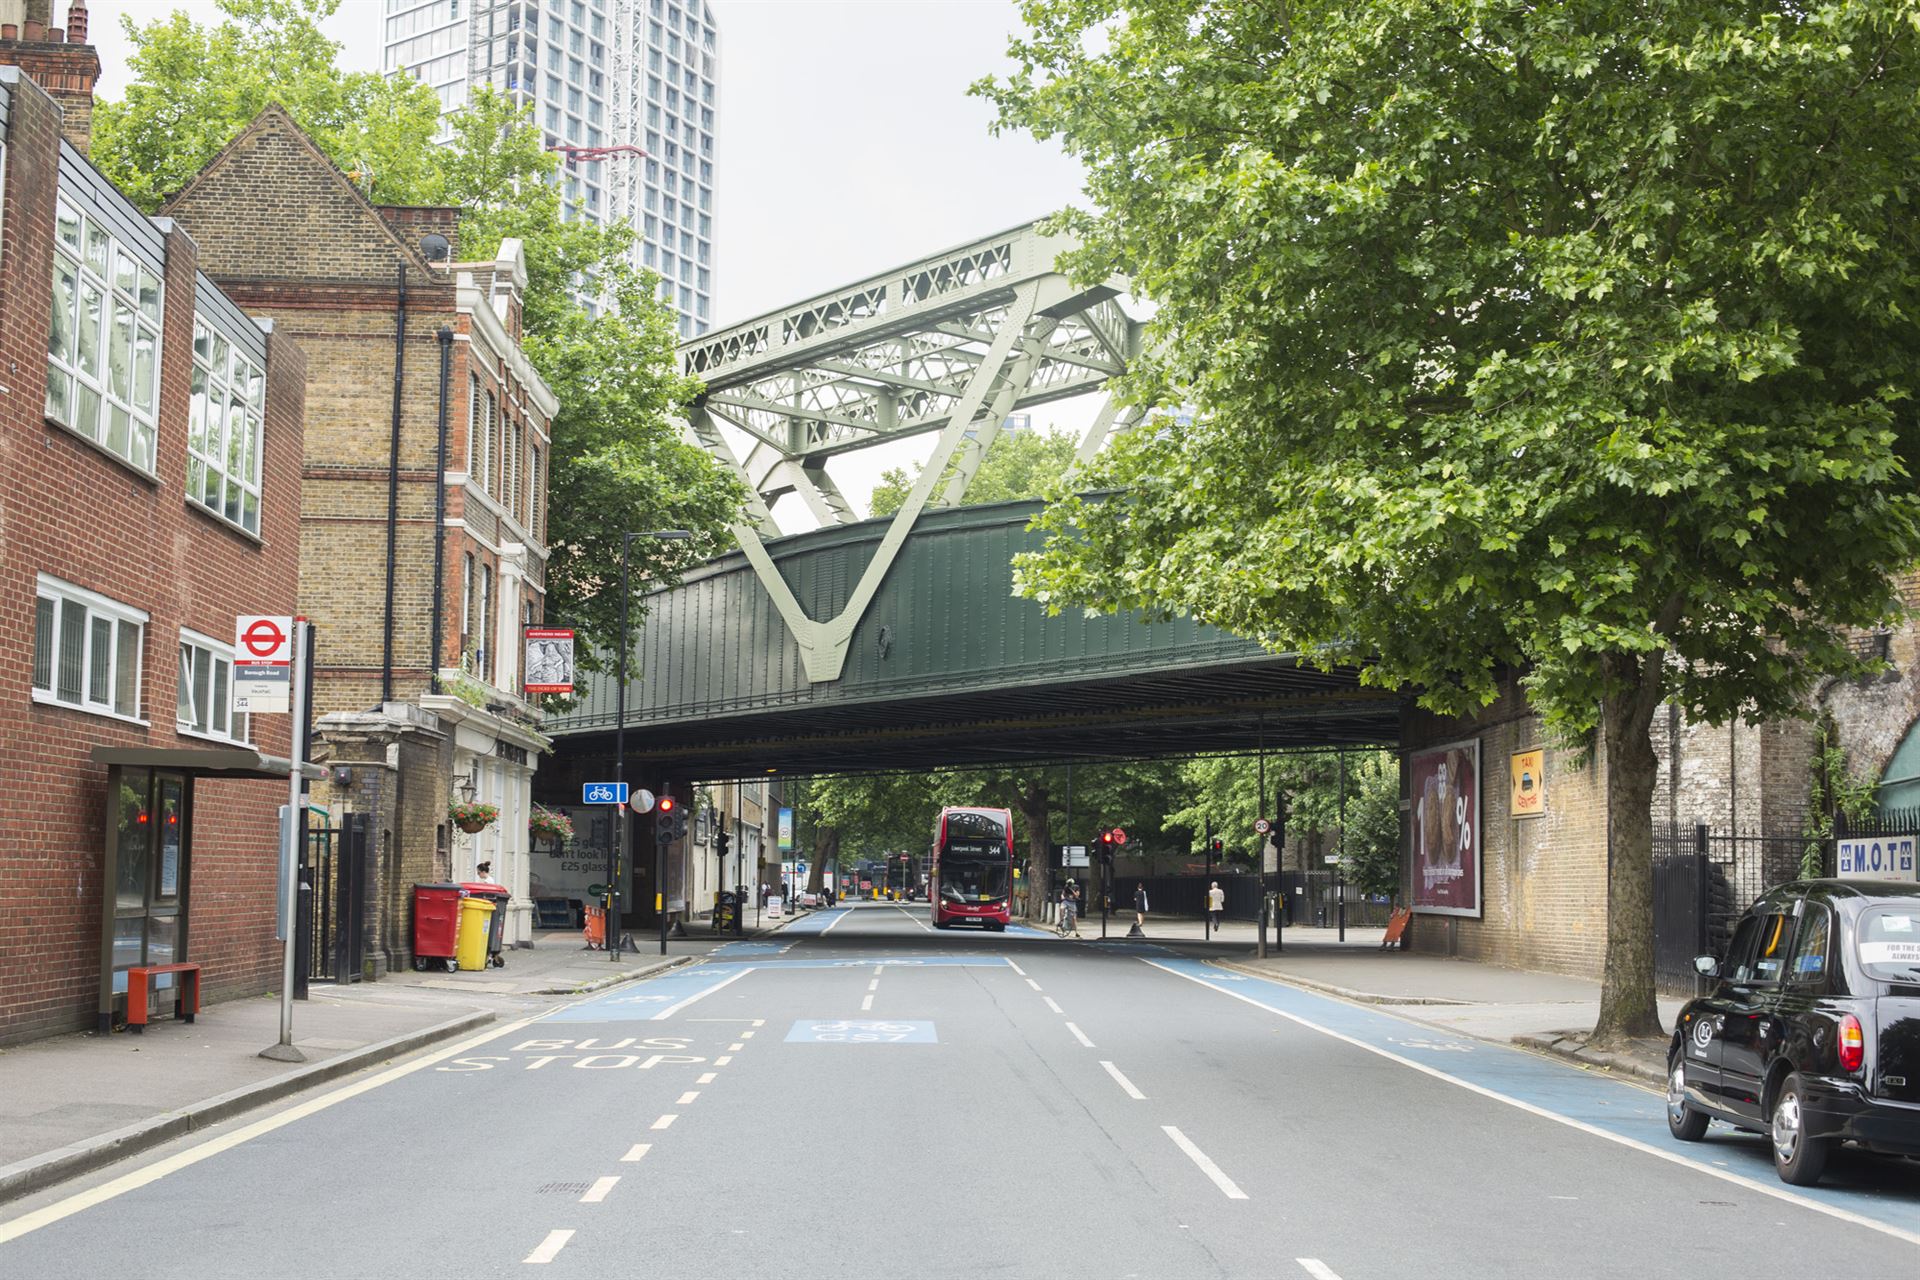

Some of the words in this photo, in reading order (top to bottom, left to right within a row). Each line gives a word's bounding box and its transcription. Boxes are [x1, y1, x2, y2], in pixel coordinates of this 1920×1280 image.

[1522, 757, 1534, 768] TAXI
[577, 848, 599, 859] look
[988, 846, 1000, 854] 344
[561, 862, 580, 871] £25
[816, 1033, 908, 1042] CS7
[510, 1037, 694, 1050] BUS
[435, 1054, 706, 1072] STOP
